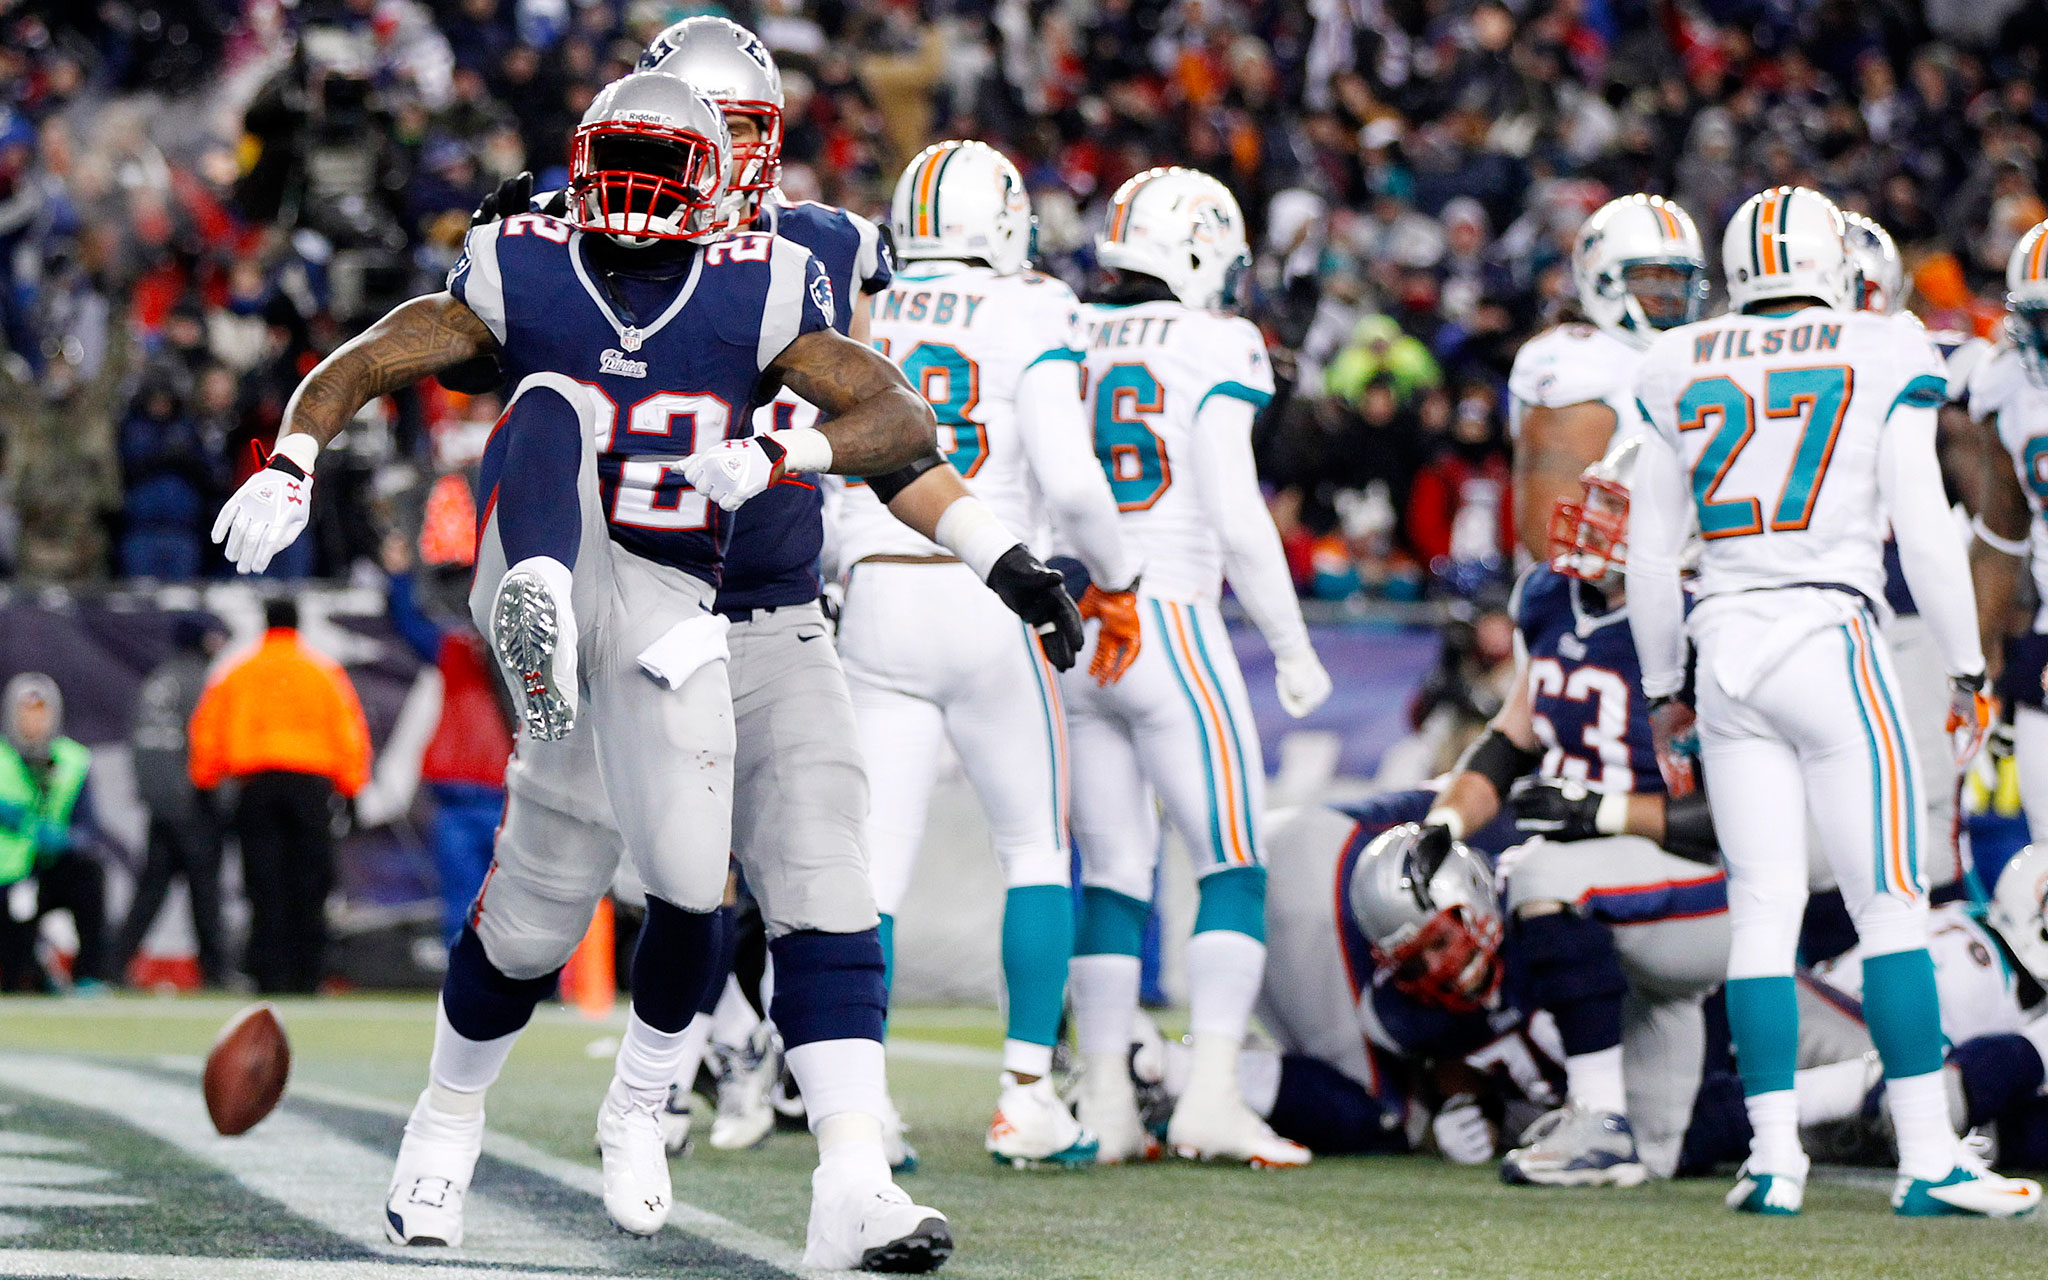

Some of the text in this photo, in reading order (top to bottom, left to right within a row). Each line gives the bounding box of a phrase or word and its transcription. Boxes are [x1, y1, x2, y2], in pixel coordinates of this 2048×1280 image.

[628, 112, 661, 123] Riddell
[871, 338, 990, 481] 8
[1693, 322, 1844, 363] WILSON
[1080, 362, 1172, 513] 6
[1676, 365, 1855, 541] 27
[1527, 656, 1636, 795] 63
